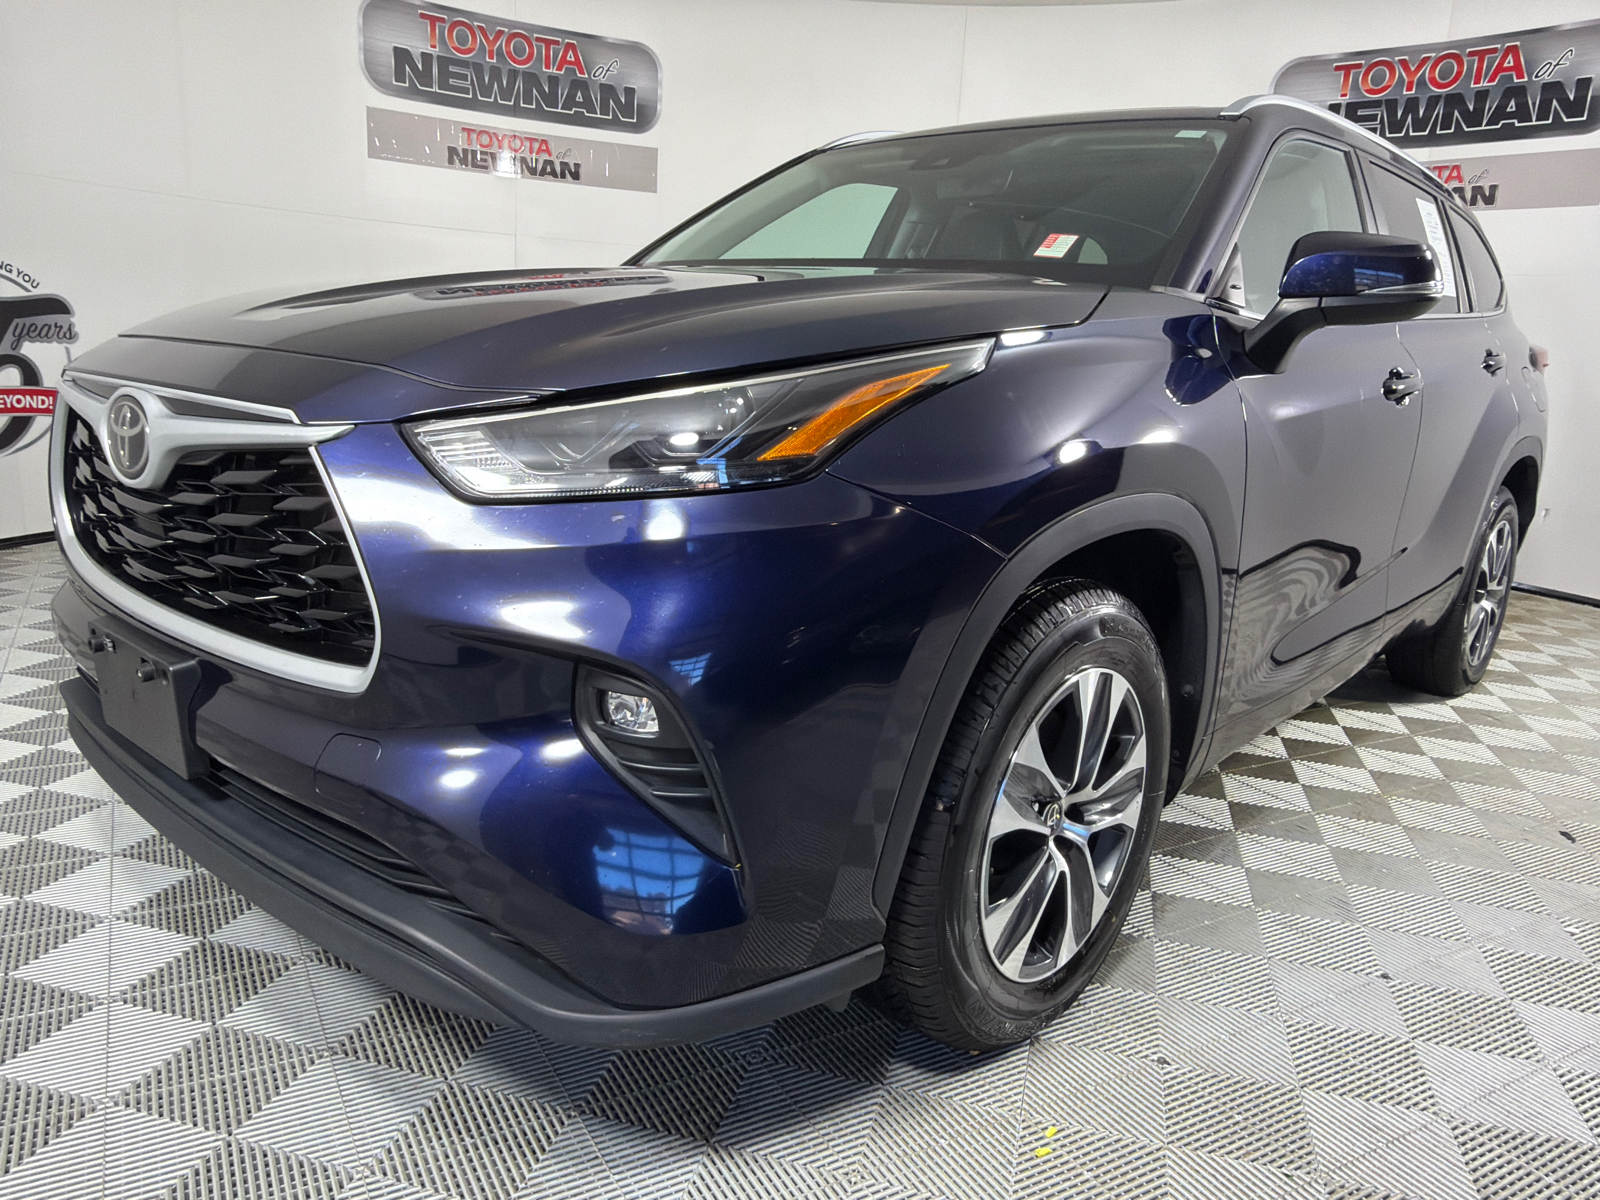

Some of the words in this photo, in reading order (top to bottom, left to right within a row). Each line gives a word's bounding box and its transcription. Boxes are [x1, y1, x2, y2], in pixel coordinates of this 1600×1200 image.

[418, 10, 588, 77] TOYOTA
[591, 59, 619, 80] of
[392, 45, 637, 122] NEWNAN
[1333, 42, 1528, 98] TOYOTA
[1533, 48, 1574, 80] of
[461, 126, 552, 158] TOYOTA
[16, 267, 40, 289] YOU
[10, 321, 77, 351] years
